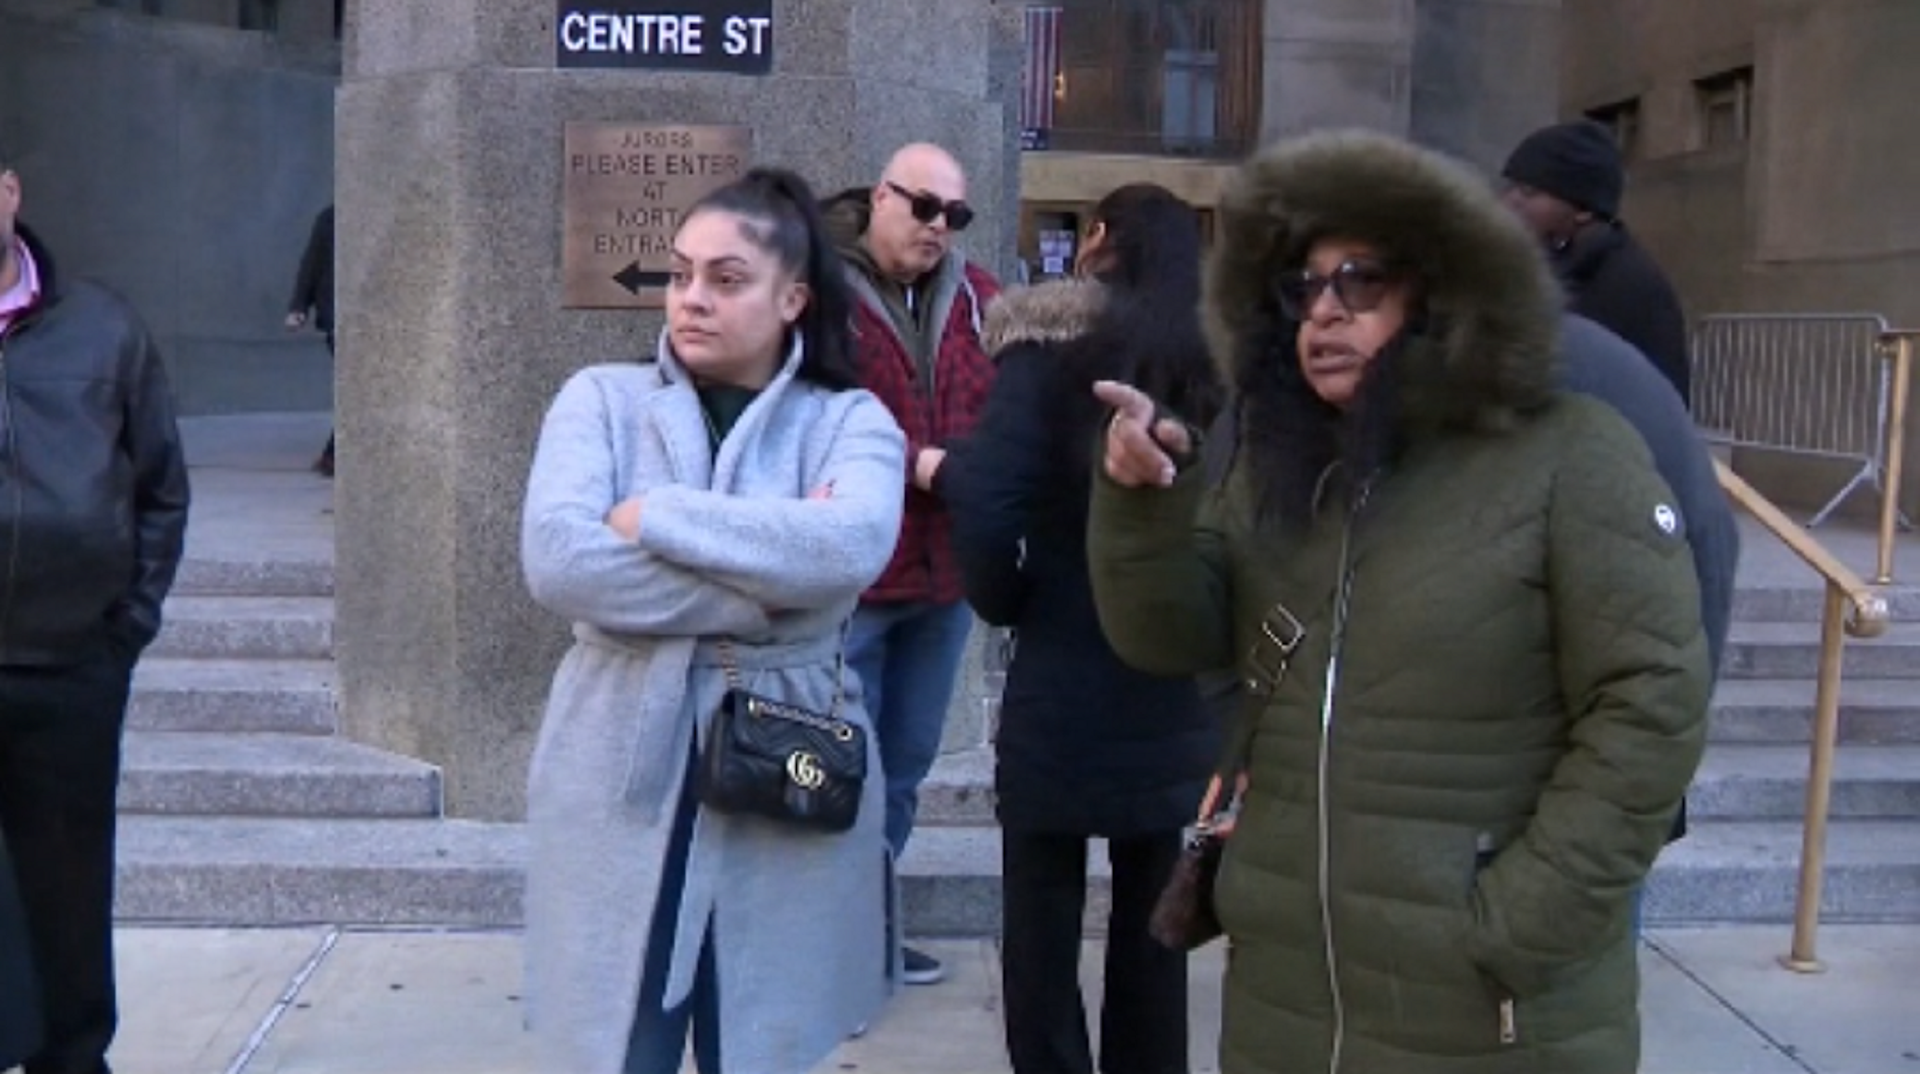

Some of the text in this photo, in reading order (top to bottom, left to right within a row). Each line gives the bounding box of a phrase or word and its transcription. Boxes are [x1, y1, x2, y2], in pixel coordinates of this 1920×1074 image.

[561, 12, 770, 55] CENTRE ST
[621, 132, 693, 148] JURORS
[572, 154, 739, 175] PLEASE ENTER
[643, 182, 668, 201] AT
[617, 208, 683, 228] NORT
[594, 235, 675, 254] ENTRA
